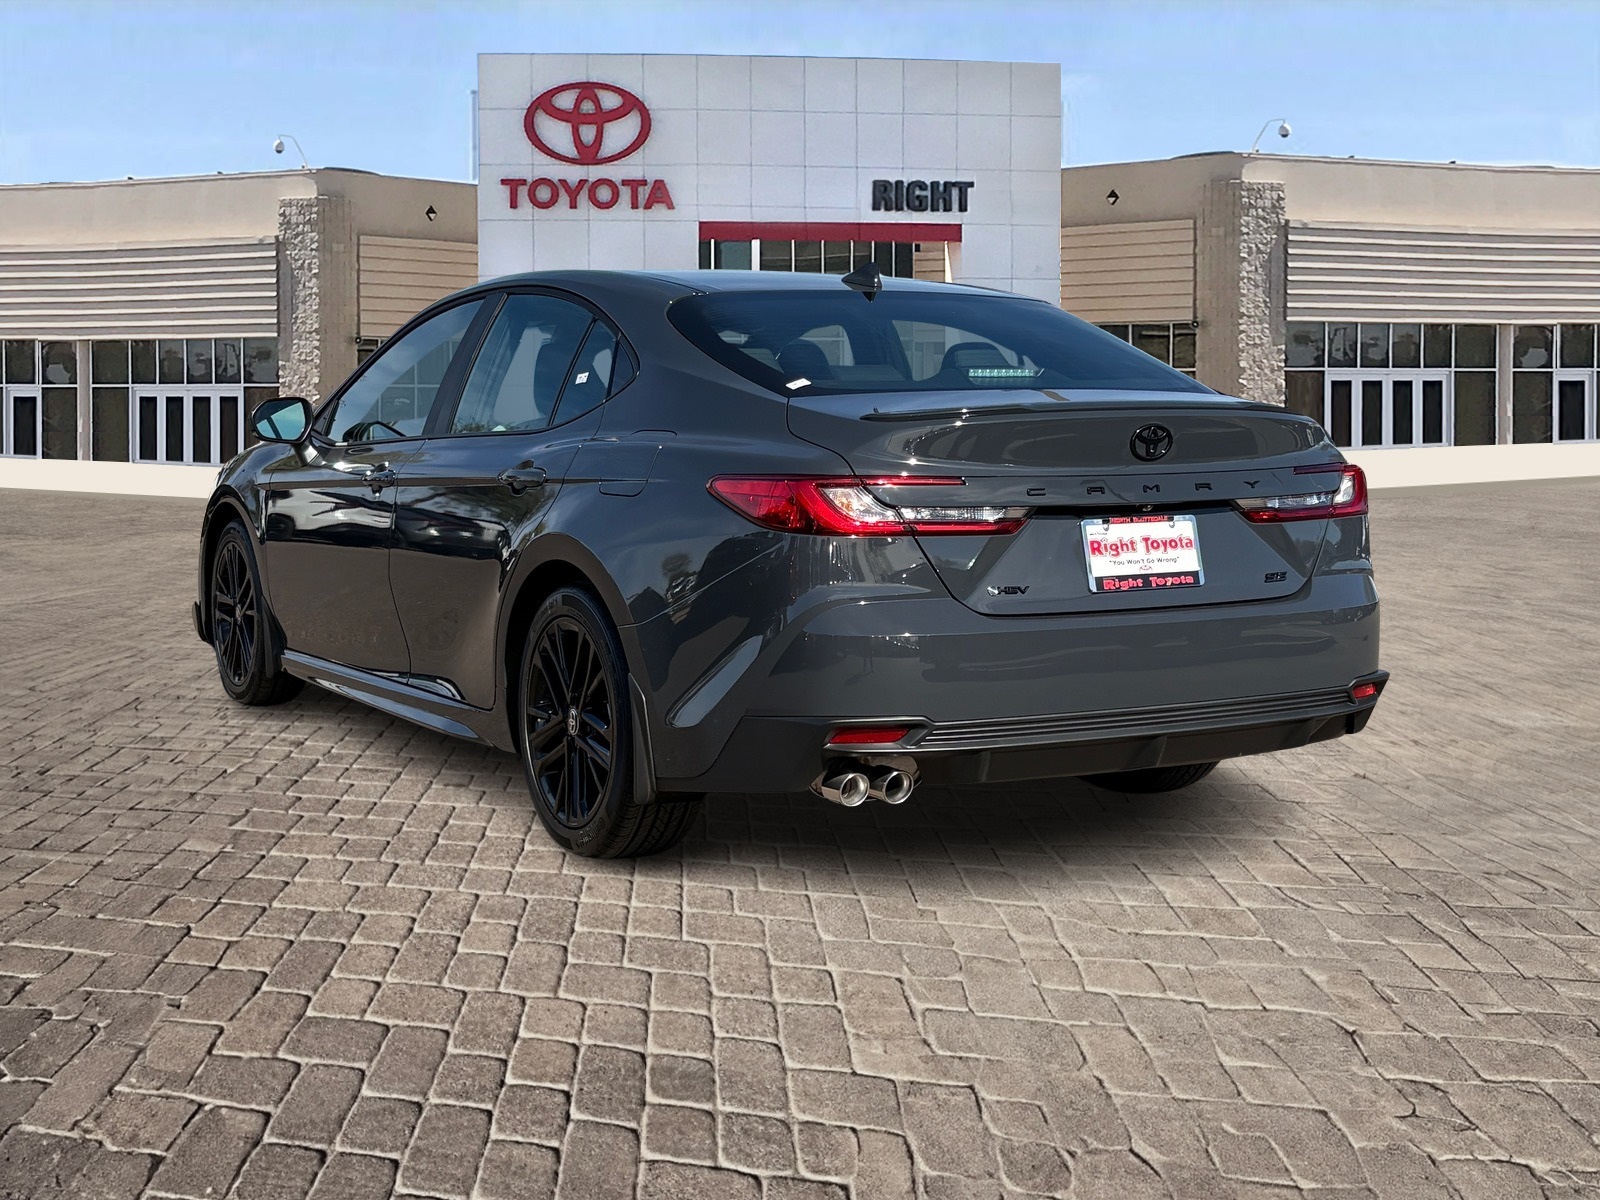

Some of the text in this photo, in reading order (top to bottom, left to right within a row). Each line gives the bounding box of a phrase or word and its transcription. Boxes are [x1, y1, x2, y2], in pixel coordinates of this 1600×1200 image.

[500, 179, 675, 210] TOYOTA
[872, 179, 975, 212] RIGHT
[1026, 479, 1261, 496] CAMRY
[1089, 534, 1194, 557] Right Toyota
[997, 586, 1030, 595] HEV
[1103, 575, 1195, 590] Right Toyota
